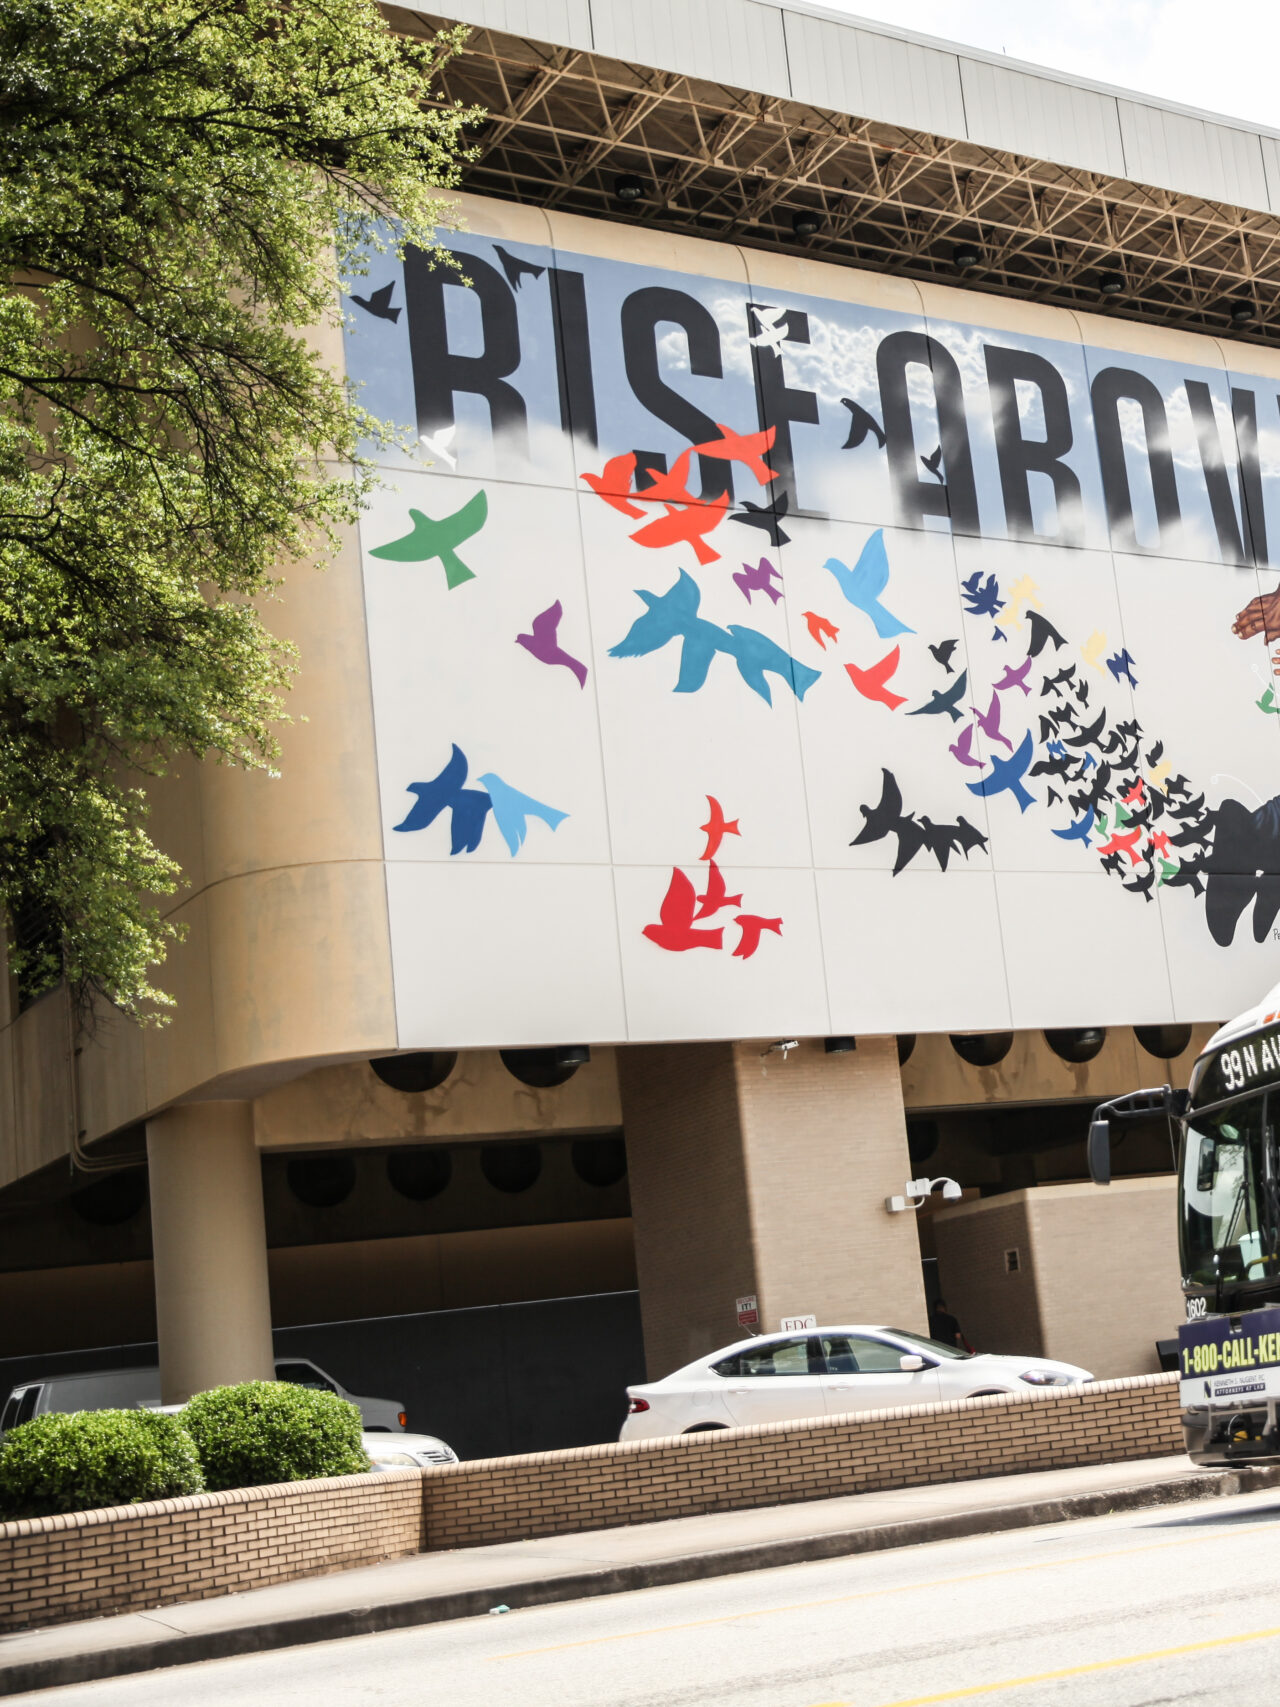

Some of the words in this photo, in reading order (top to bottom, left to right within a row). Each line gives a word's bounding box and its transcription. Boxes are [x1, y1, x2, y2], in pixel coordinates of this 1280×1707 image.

[403, 243, 830, 522] RISE
[1220, 1050, 1246, 1091] 99
[1243, 1044, 1259, 1077] N
[1187, 1297, 1208, 1318] 1602
